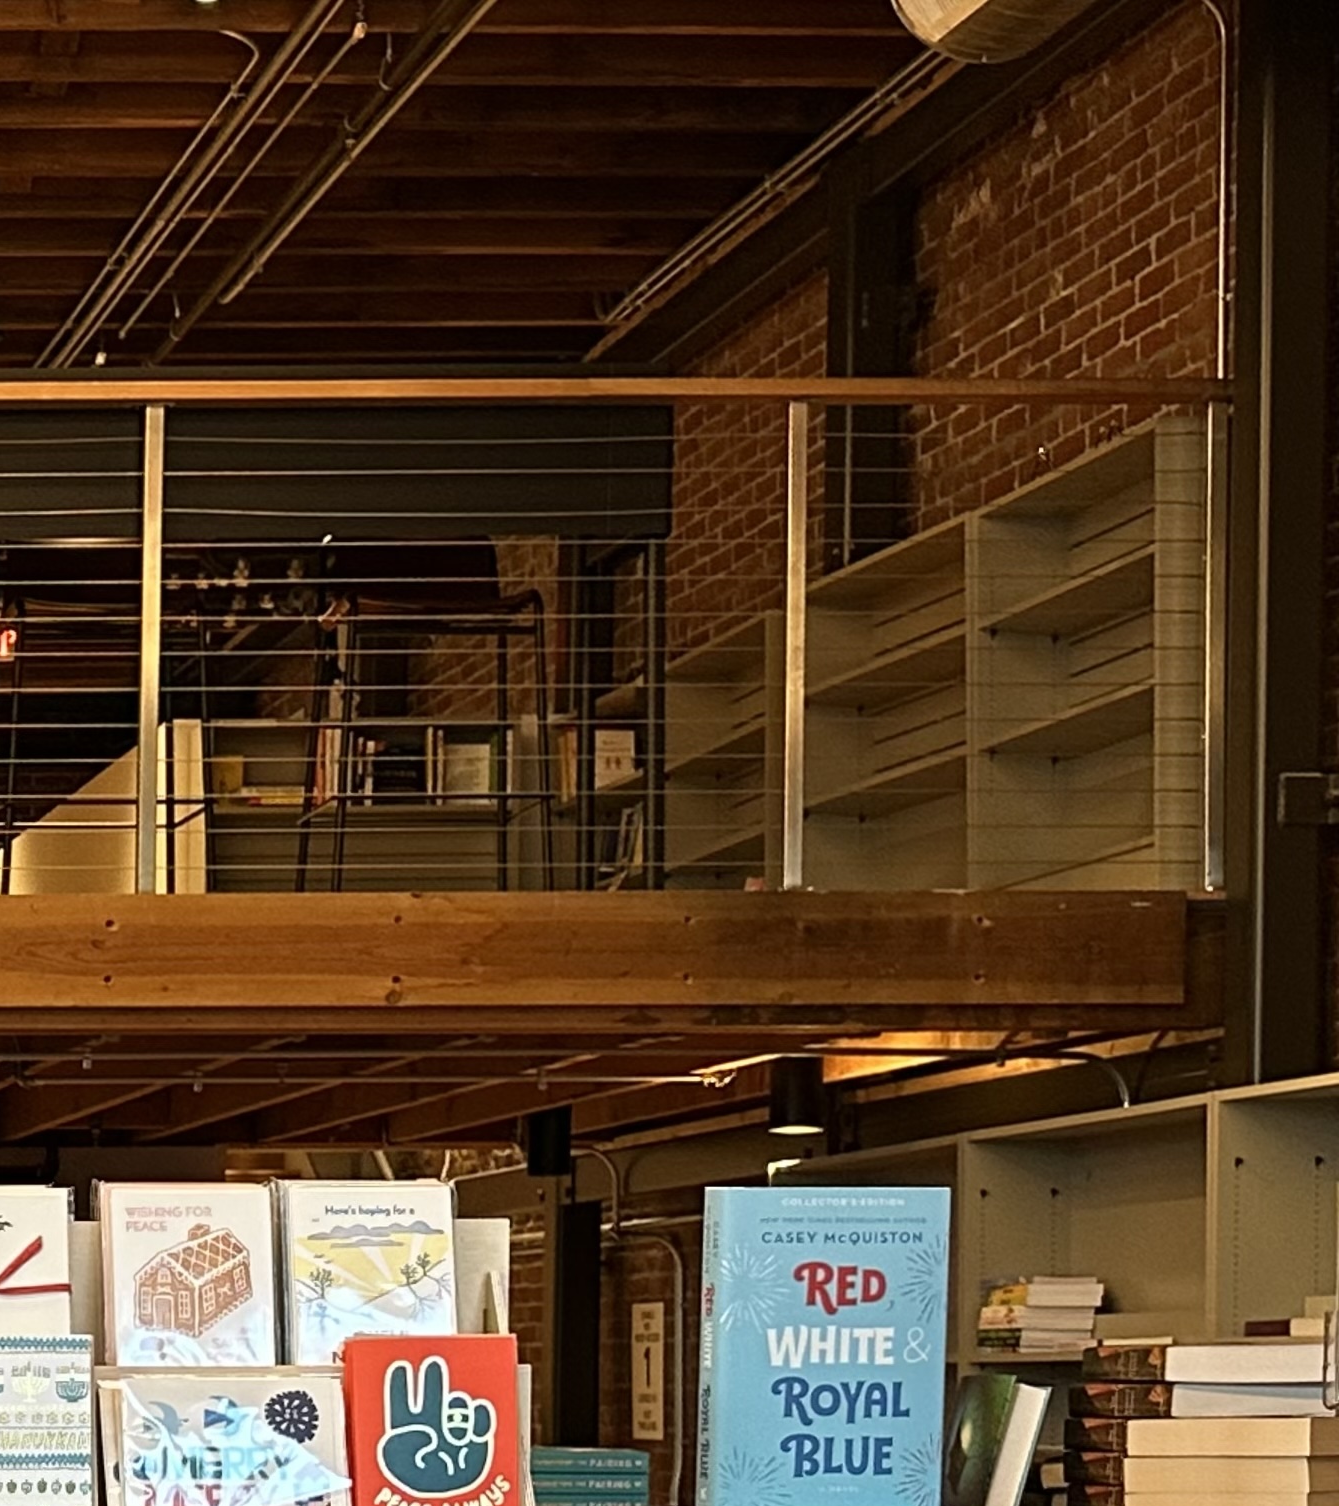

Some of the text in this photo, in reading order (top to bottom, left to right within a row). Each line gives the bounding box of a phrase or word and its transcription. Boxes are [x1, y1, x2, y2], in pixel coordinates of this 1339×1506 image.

[125, 1206, 211, 1219] WISHING FOR
[325, 1204, 356, 1217] Here's
[359, 1204, 393, 1219] hoping
[396, 1204, 409, 1216] for
[125, 1222, 167, 1232] PEACE
[761, 1231, 923, 1245] CASEY McQUISTON
[793, 1261, 895, 1314] RED,
[768, 1324, 929, 1368] WHITE &
[772, 1378, 910, 1423] ROYAL
[780, 1435, 893, 1477] BLUE
